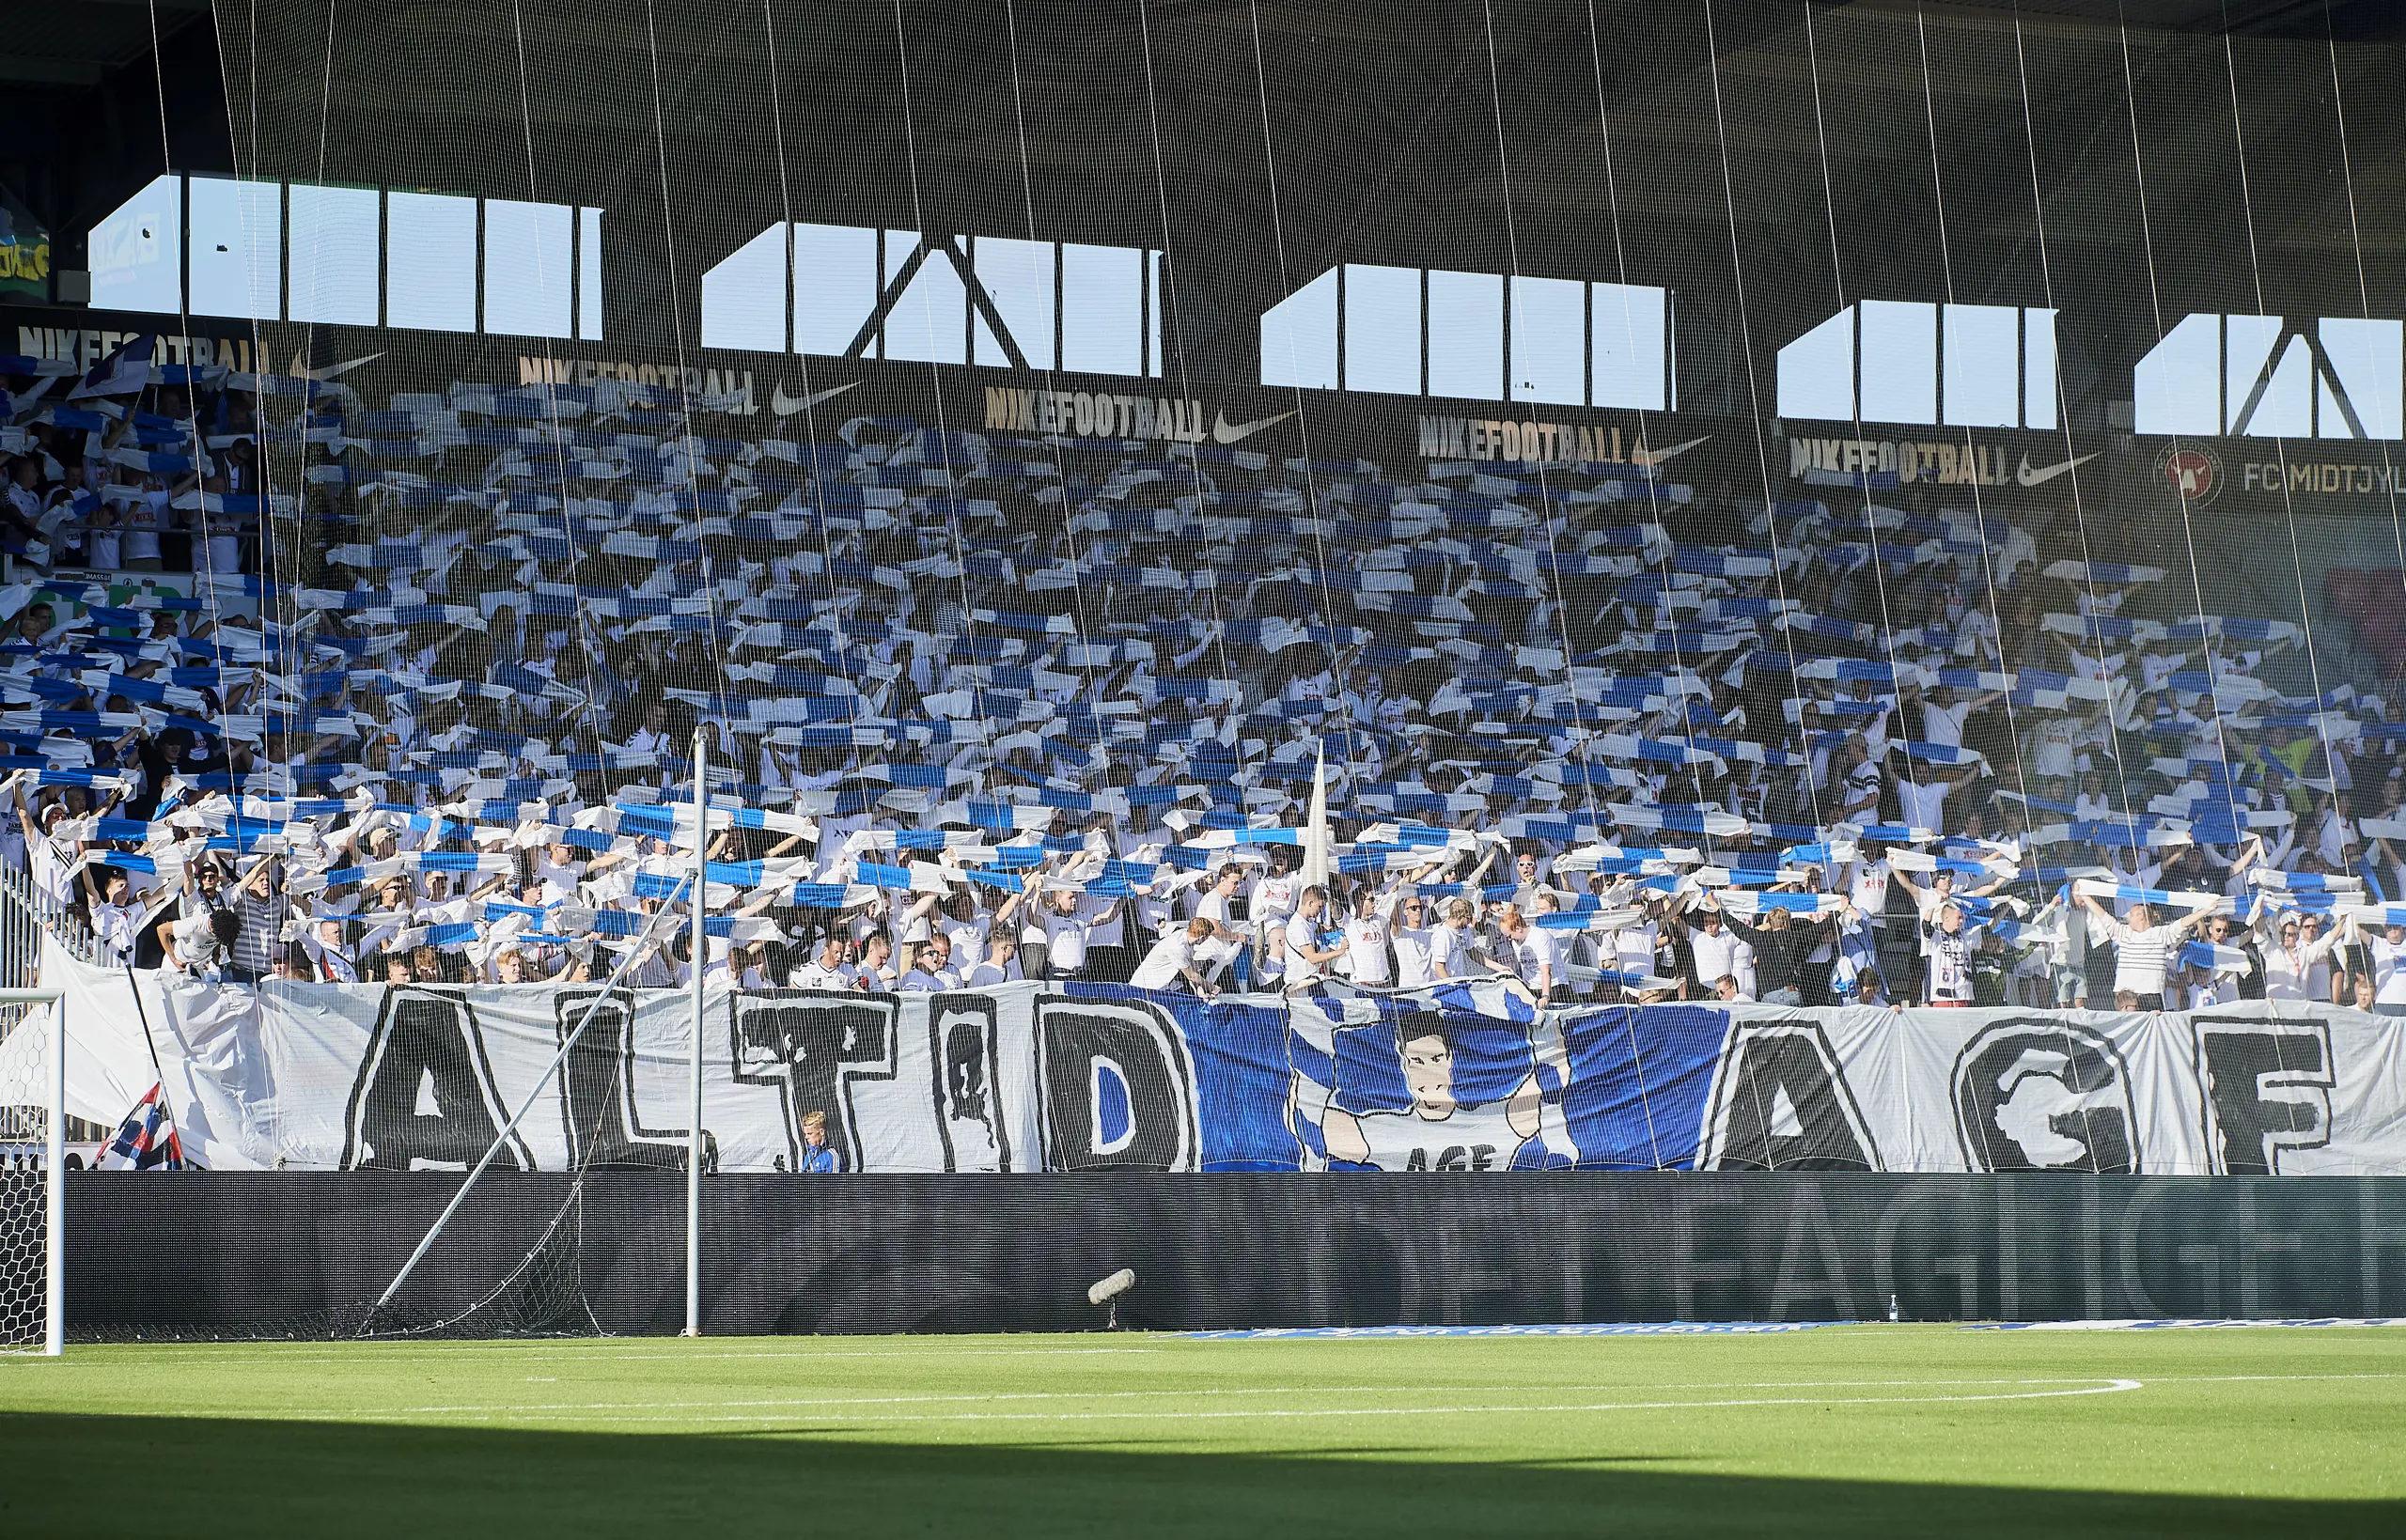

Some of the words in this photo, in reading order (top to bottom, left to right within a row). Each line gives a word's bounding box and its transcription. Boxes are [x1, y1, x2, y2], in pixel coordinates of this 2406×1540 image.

[985, 386, 1208, 443] NIKEFOOTBALL
[1418, 415, 1629, 464] NIKEFOOTBALL
[2244, 463, 2281, 491] FC
[339, 983, 1203, 1174] ALTID
[1697, 1016, 2336, 1176] AGF
[1407, 1144, 1497, 1172] AGF
